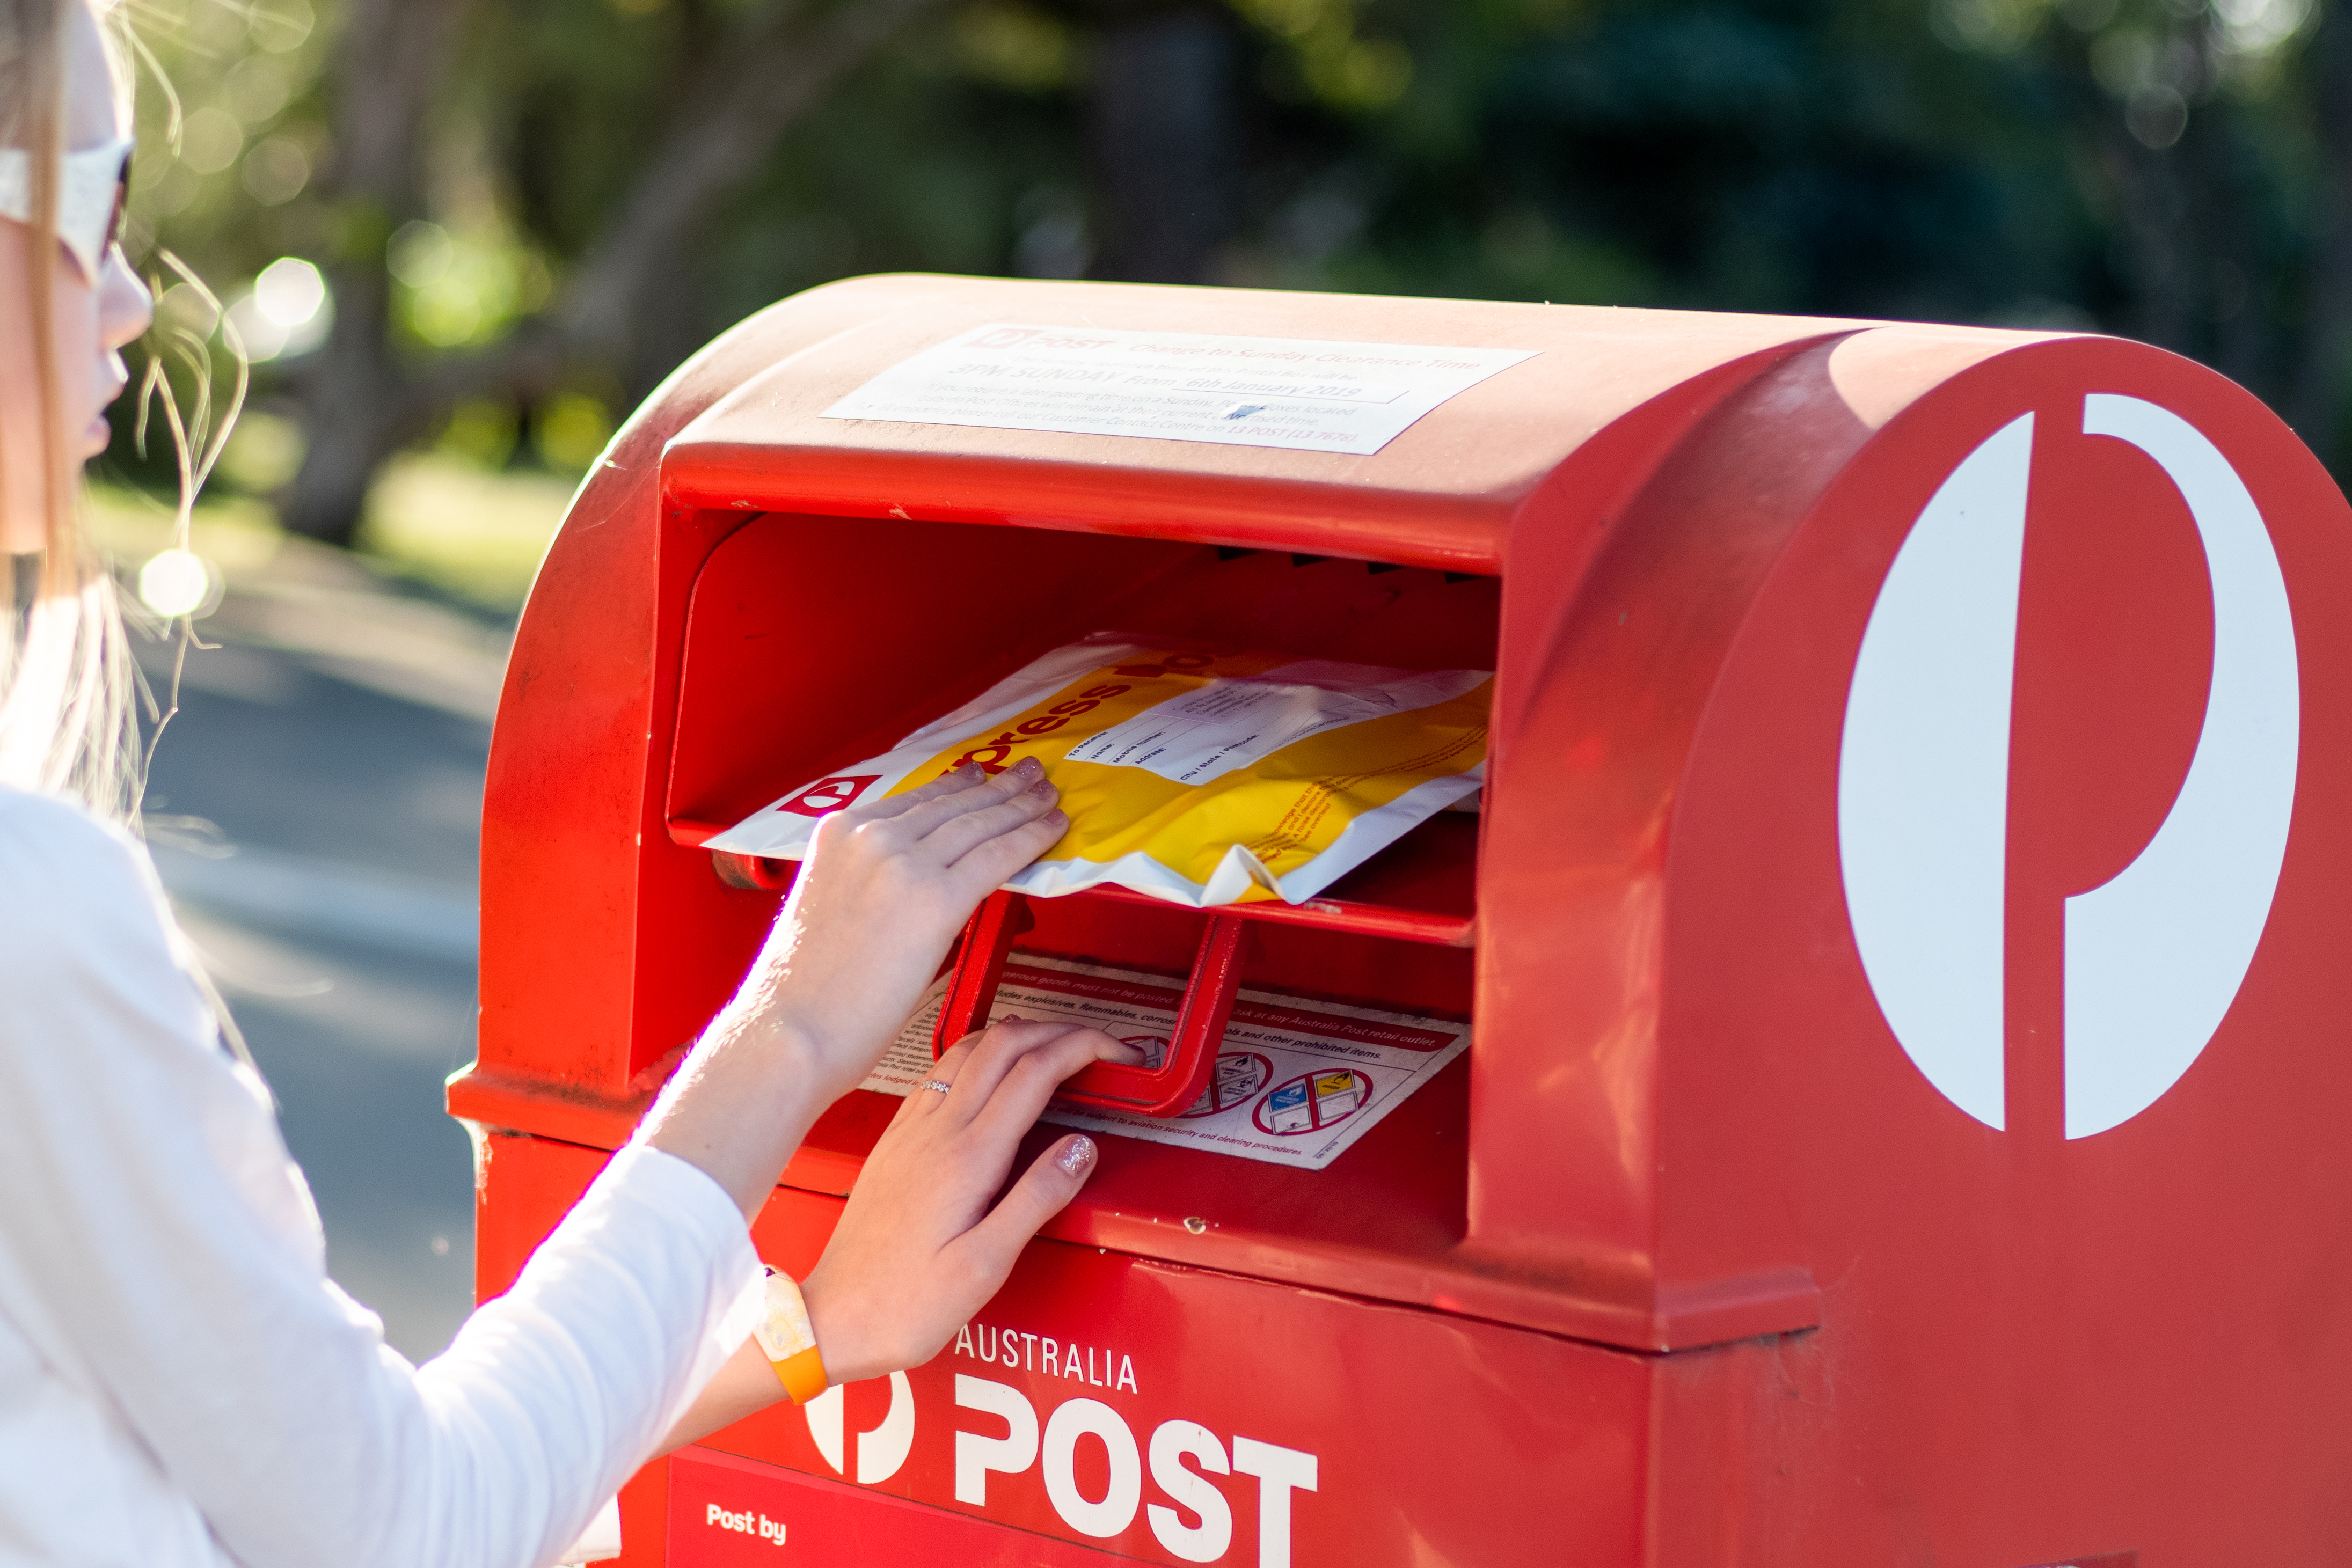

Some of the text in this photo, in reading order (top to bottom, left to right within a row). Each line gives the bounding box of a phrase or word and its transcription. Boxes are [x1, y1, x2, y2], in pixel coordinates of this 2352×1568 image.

[1020, 337, 1117, 349] POST
[1129, 344, 1206, 356] Change
[1233, 349, 1314, 362] Sunday
[1316, 354, 1422, 367] Clearance
[1426, 359, 1480, 369] Time
[949, 364, 1362, 397] 3PM SUNDAY From 6th January 2019
[1090, 360, 1154, 369] clearance
[1155, 364, 1188, 372] time
[925, 383, 940, 391] If
[965, 386, 1008, 395] require
[1020, 388, 1051, 396] later
[1048, 390, 1100, 401] posting
[1100, 393, 1131, 401] time
[1162, 397, 1213, 407] Sunday,
[1260, 402, 1299, 412] Boxes
[1302, 405, 1362, 415] located
[997, 398, 1037, 408] Offices
[1065, 403, 1110, 413] remain
[1128, 405, 1161, 415] their
[1161, 409, 1212, 419] current
[1285, 416, 1319, 426] time.
[894, 405, 948, 414] enquiries
[949, 409, 993, 417] please
[994, 411, 1018, 419] call
[1042, 413, 1107, 424] Customer
[1106, 417, 1159, 428] Contact
[1159, 420, 1205, 431] Centre
[1226, 426, 1246, 434] 13
[1247, 427, 1290, 436] POST
[1286, 429, 1314, 439] (13
[940, 684, 1132, 776] press
[1078, 732, 1108, 749] Receiver
[1091, 744, 1115, 759] Name:
[1113, 732, 1166, 763] Mobile number:
[1135, 748, 1166, 764] Address:
[1180, 771, 1198, 780] City
[1199, 755, 1221, 767] State
[1223, 735, 1260, 751] Postcode:
[1288, 817, 1299, 830] and
[1301, 791, 1320, 814] declare
[1294, 794, 1308, 807] that
[1297, 816, 1311, 832] false
[1310, 803, 1331, 830] overleaf
[1001, 970, 1038, 981] gerous
[1037, 976, 1071, 988] goods
[1072, 981, 1100, 992] must
[1100, 986, 1121, 994] not
[1122, 988, 1135, 997] be
[1133, 993, 1174, 1004] posted.
[996, 990, 1176, 1026] ludes explosives, flammables, corrosi
[1233, 1009, 1251, 1017] ask
[1271, 1015, 1289, 1024] any
[1292, 1016, 1340, 1030] Australia
[1341, 1024, 1368, 1036] Post
[1368, 1030, 1400, 1041] retail
[1400, 1035, 1436, 1046] outlet.
[1241, 1030, 1262, 1039] and
[1263, 1034, 1293, 1044] other
[1291, 1039, 1350, 1053] prohibited
[1350, 1047, 1381, 1059] items.
[899, 1058, 921, 1067] Separate
[883, 1075, 912, 1085] lodged
[1085, 1112, 1116, 1122] subject
[1128, 1121, 1164, 1131] aviation
[1164, 1126, 1199, 1137] security
[1217, 1135, 1252, 1147] clearing
[1251, 1142, 1302, 1155] procedures
[954, 1323, 1138, 1394] AUSTRALIA
[955, 1373, 1318, 1568] POST
[706, 1503, 786, 1546] Post by
